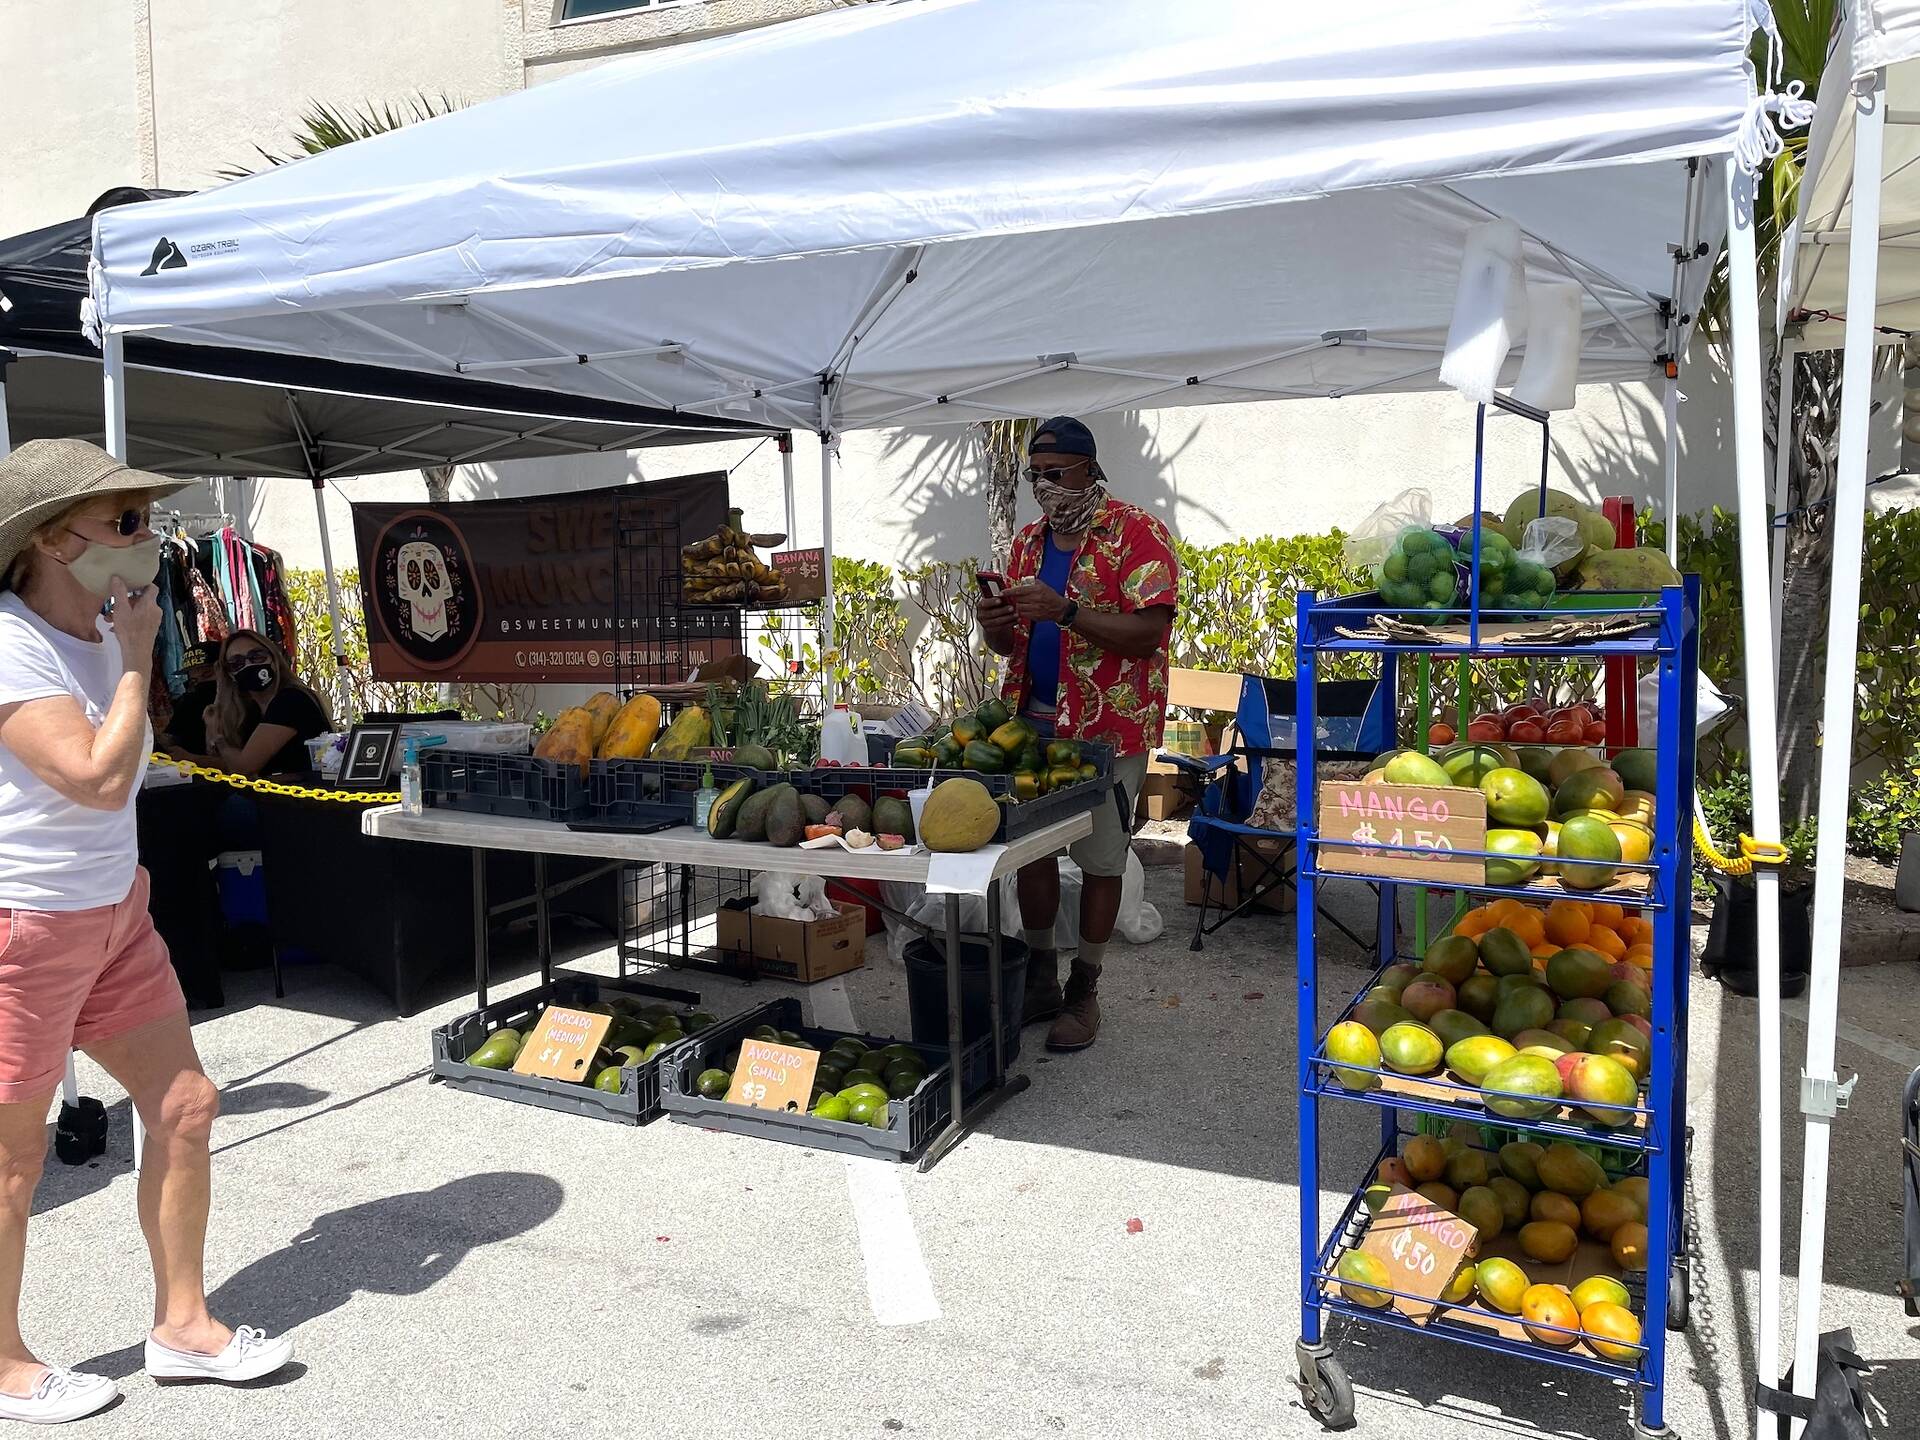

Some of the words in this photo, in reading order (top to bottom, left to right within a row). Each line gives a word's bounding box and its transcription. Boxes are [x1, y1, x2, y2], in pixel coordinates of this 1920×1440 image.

[190, 243, 216, 253] OZARK
[217, 239, 239, 249] TRAIL
[775, 551, 820, 565] BANANA
[800, 561, 819, 579] $5
[528, 651, 564, 667] (314)-320
[565, 651, 585, 665] 0304
[1339, 790, 1450, 823] MANGO
[551, 1010, 593, 1030] AVOCADO
[747, 1045, 802, 1069] AVOCADO
[748, 1060, 787, 1086] (SMALL)
[742, 1081, 768, 1101] $3
[1396, 1193, 1466, 1249] MANGO
